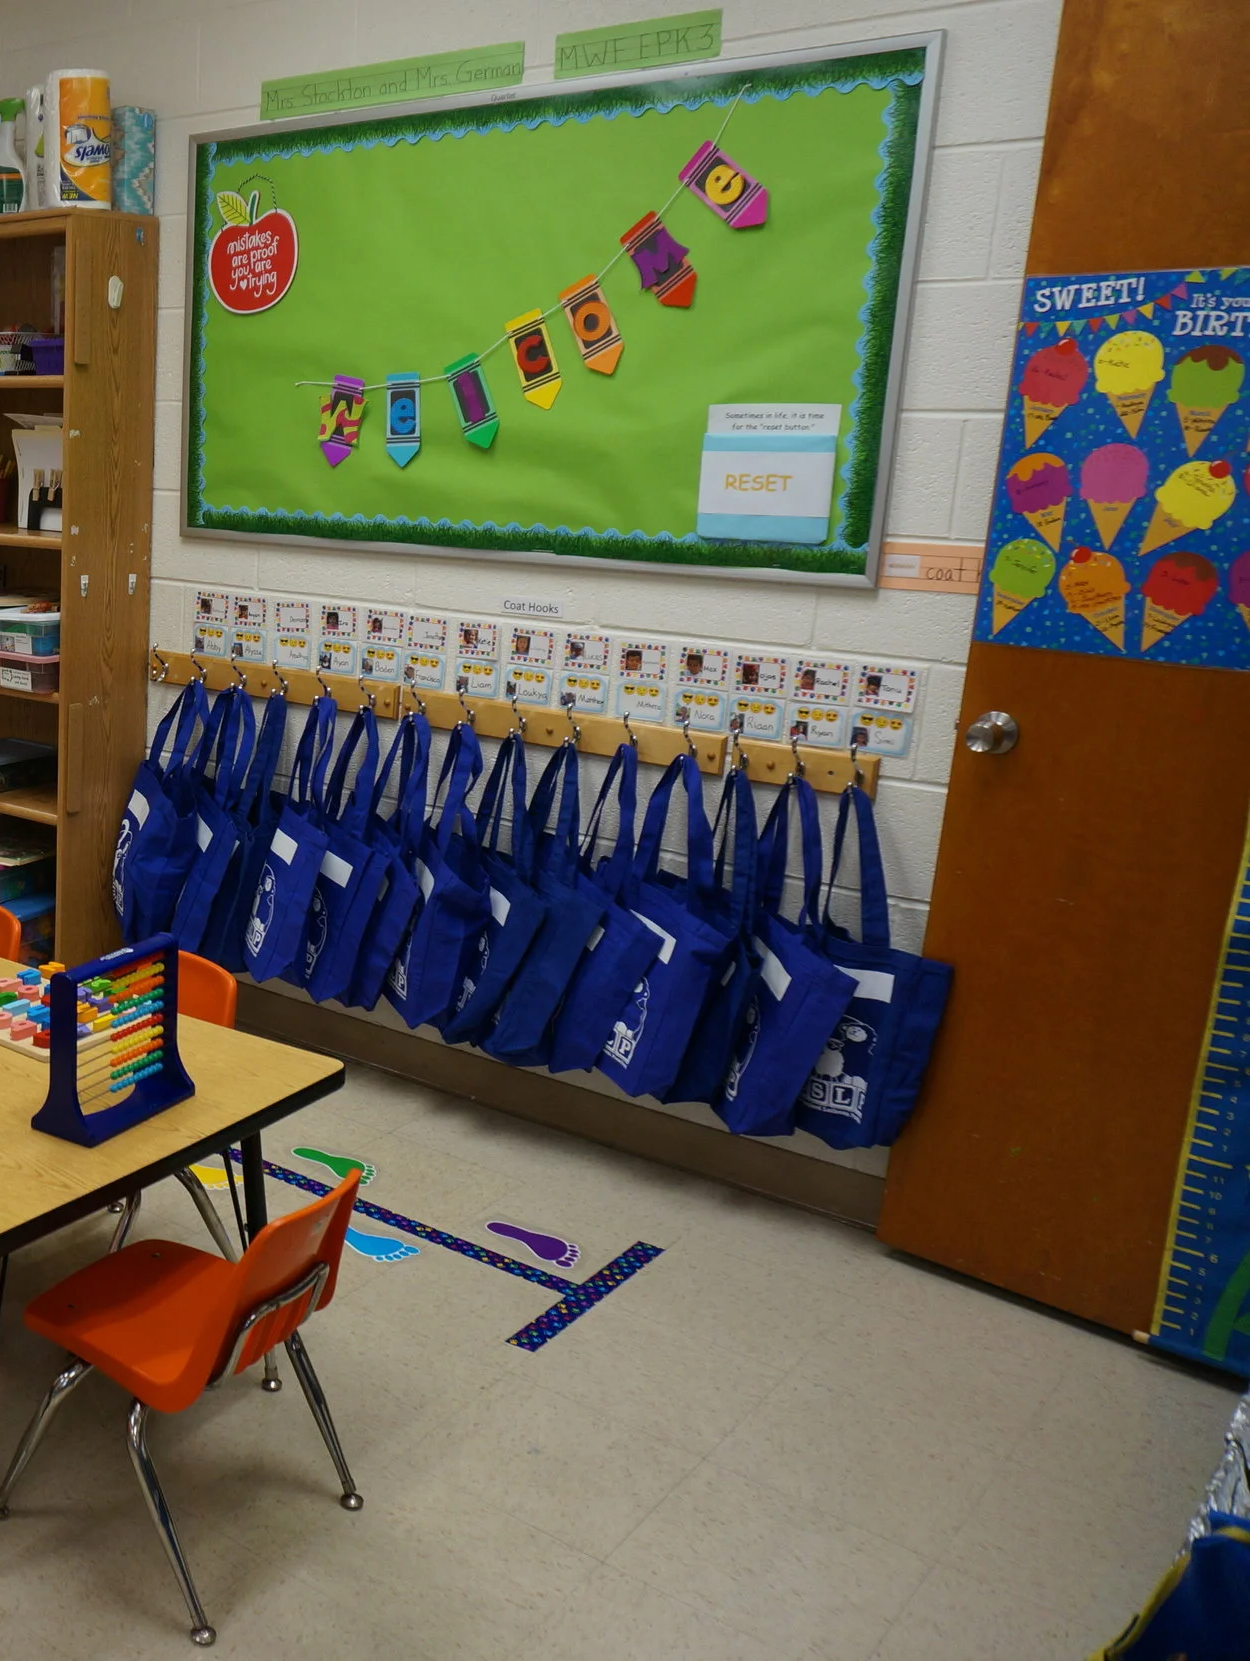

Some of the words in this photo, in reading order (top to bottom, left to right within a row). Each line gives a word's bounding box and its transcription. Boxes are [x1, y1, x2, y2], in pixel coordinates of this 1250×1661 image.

[560, 39, 626, 71] MWF
[301, 81, 372, 107] Stockton
[379, 71, 407, 94] and
[456, 60, 522, 83] German
[227, 230, 271, 255] mistakes
[232, 254, 248, 267] are
[250, 236, 279, 269] proof
[230, 266, 249, 290] you
[255, 259, 272, 273] are
[247, 271, 277, 297] trying
[1033, 276, 1146, 313] SWEET!
[1190, 293, 1217, 308] It's
[1171, 310, 1250, 337] BIRT
[724, 473, 794, 492] RESET
[504, 600, 525, 611] Coat
[529, 603, 558, 613] Hooks
[471, 677, 492, 689] Liam
[694, 710, 716, 721] Nora
